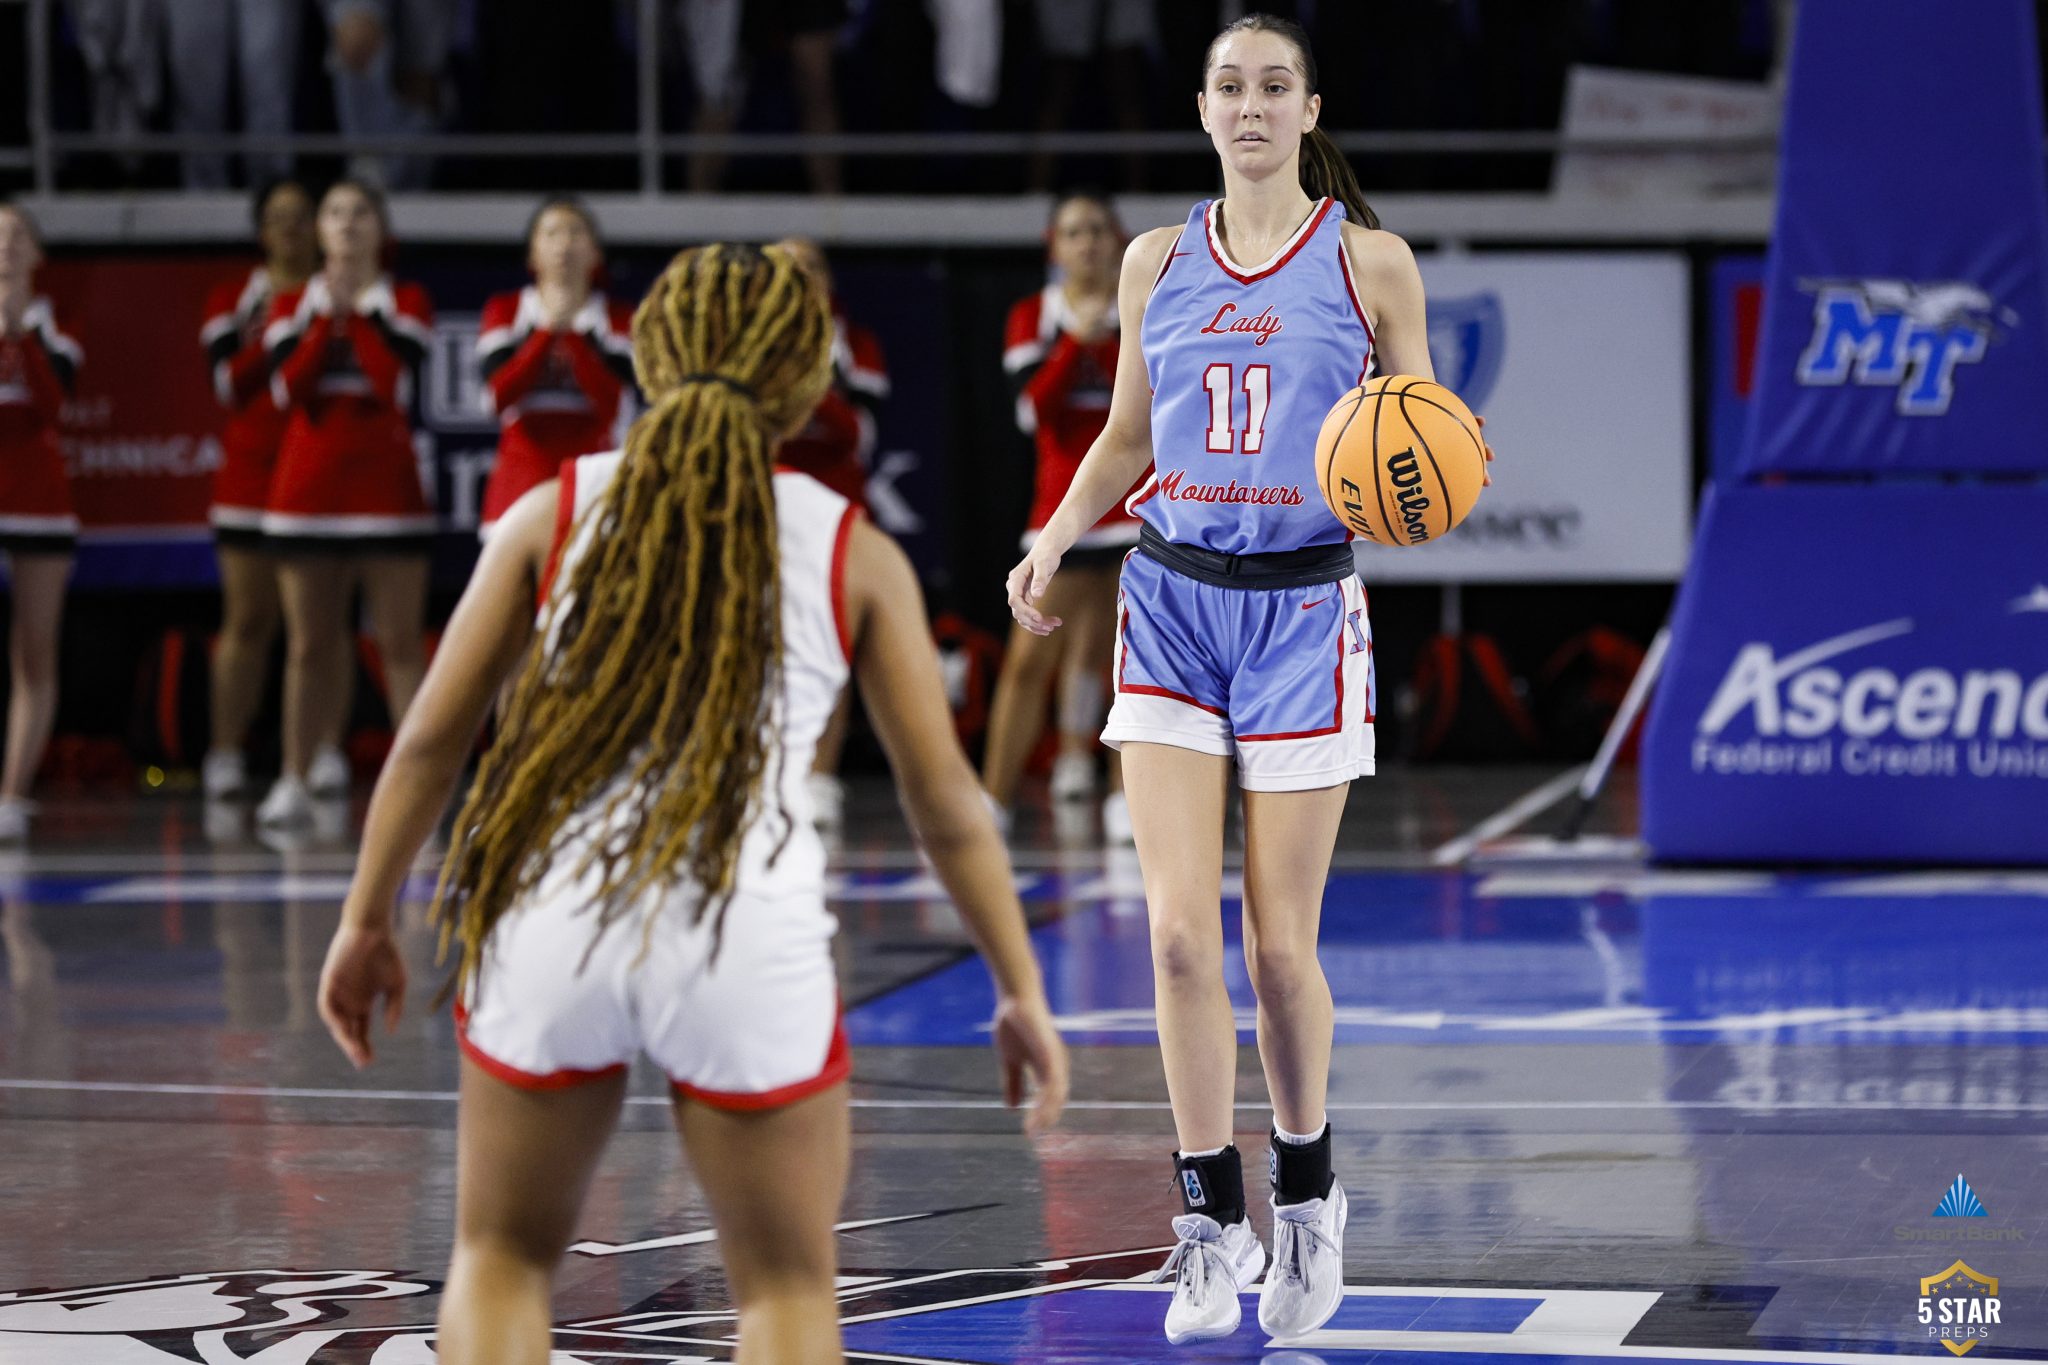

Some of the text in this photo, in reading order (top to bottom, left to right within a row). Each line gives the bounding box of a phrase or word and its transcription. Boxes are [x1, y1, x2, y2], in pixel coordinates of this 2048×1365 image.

[1200, 302, 1284, 347] Lady
[1795, 284, 1989, 418] MT
[1202, 362, 1272, 455] 11
[1160, 469, 1305, 506] Mountaneers
[1386, 446, 1431, 545] Wilson
[1691, 736, 1833, 777] Federal
[1840, 736, 1957, 778] Credit
